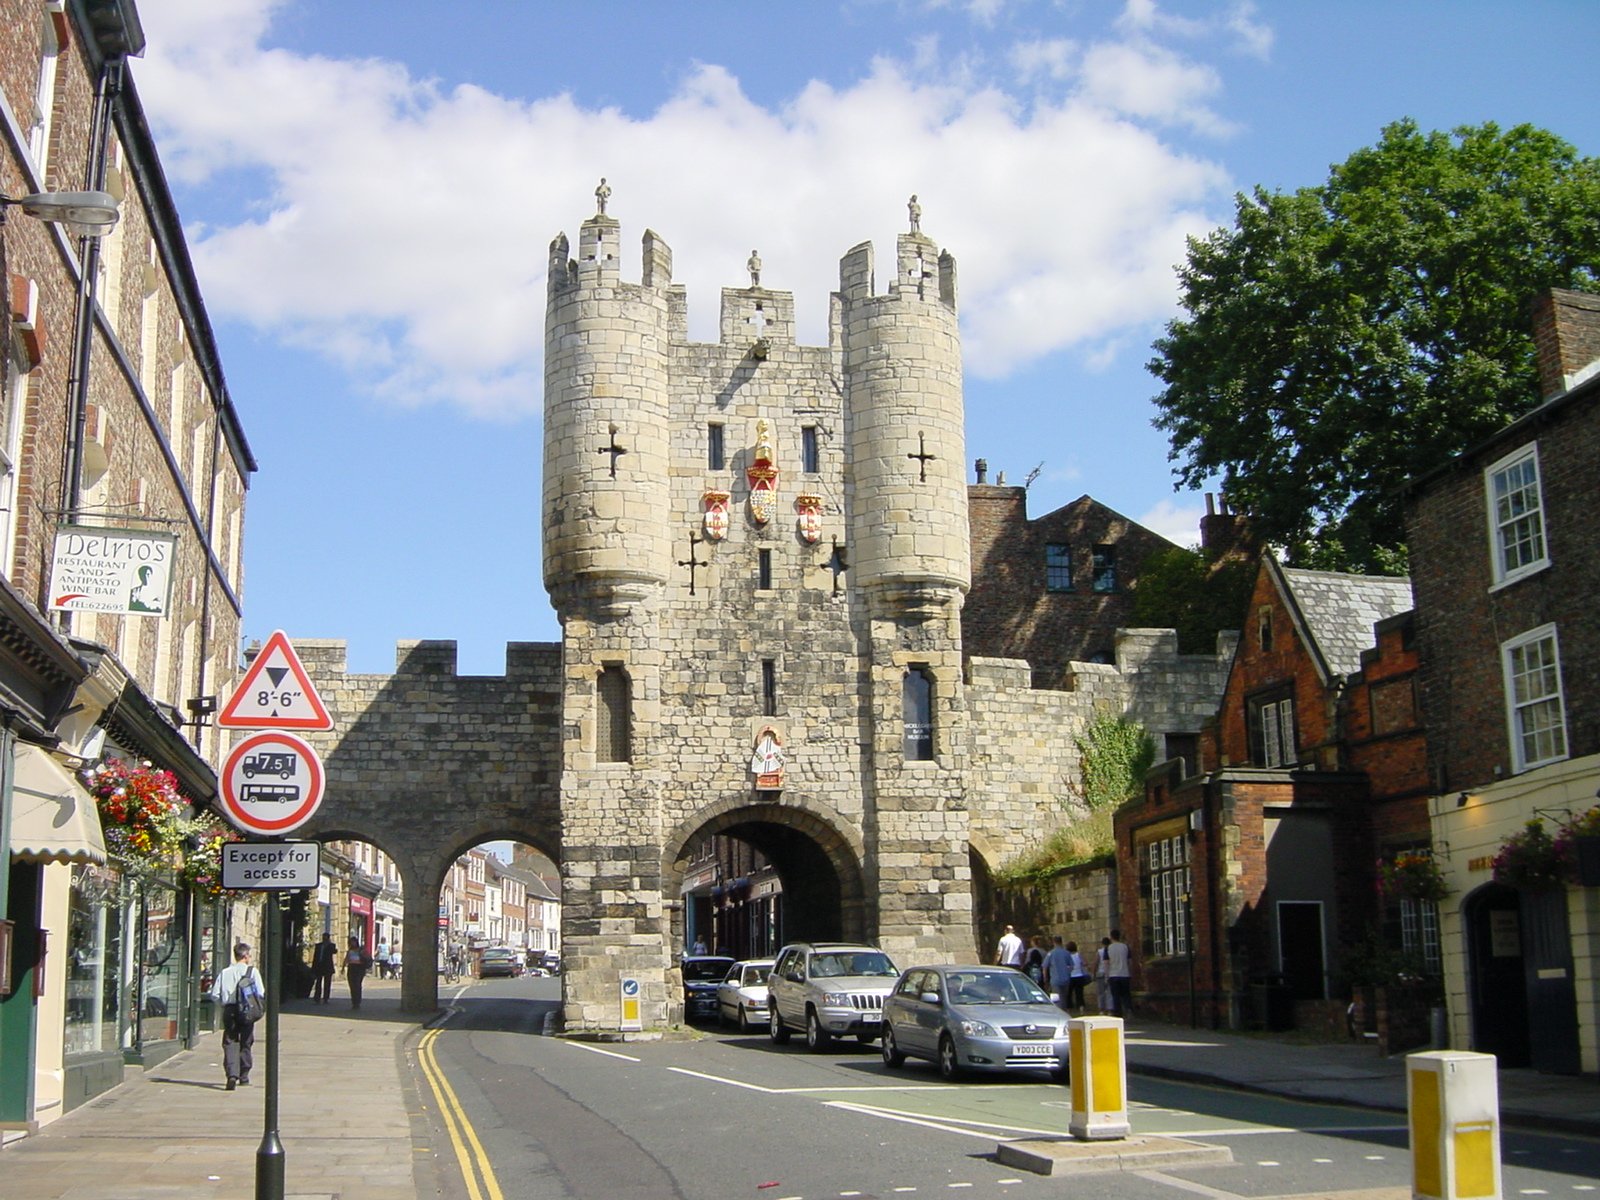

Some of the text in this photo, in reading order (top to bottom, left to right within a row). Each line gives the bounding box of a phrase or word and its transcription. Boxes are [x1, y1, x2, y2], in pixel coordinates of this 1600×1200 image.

[66, 533, 165, 562] Delrio's
[57, 557, 127, 570] RESTAURANT
[78, 567, 104, 577] AND
[59, 575, 121, 587] ANTIPASTO
[61, 584, 117, 596] WINE BAR
[70, 600, 124, 611] TEL:622695
[229, 849, 312, 865] Except for
[243, 868, 297, 880] access
